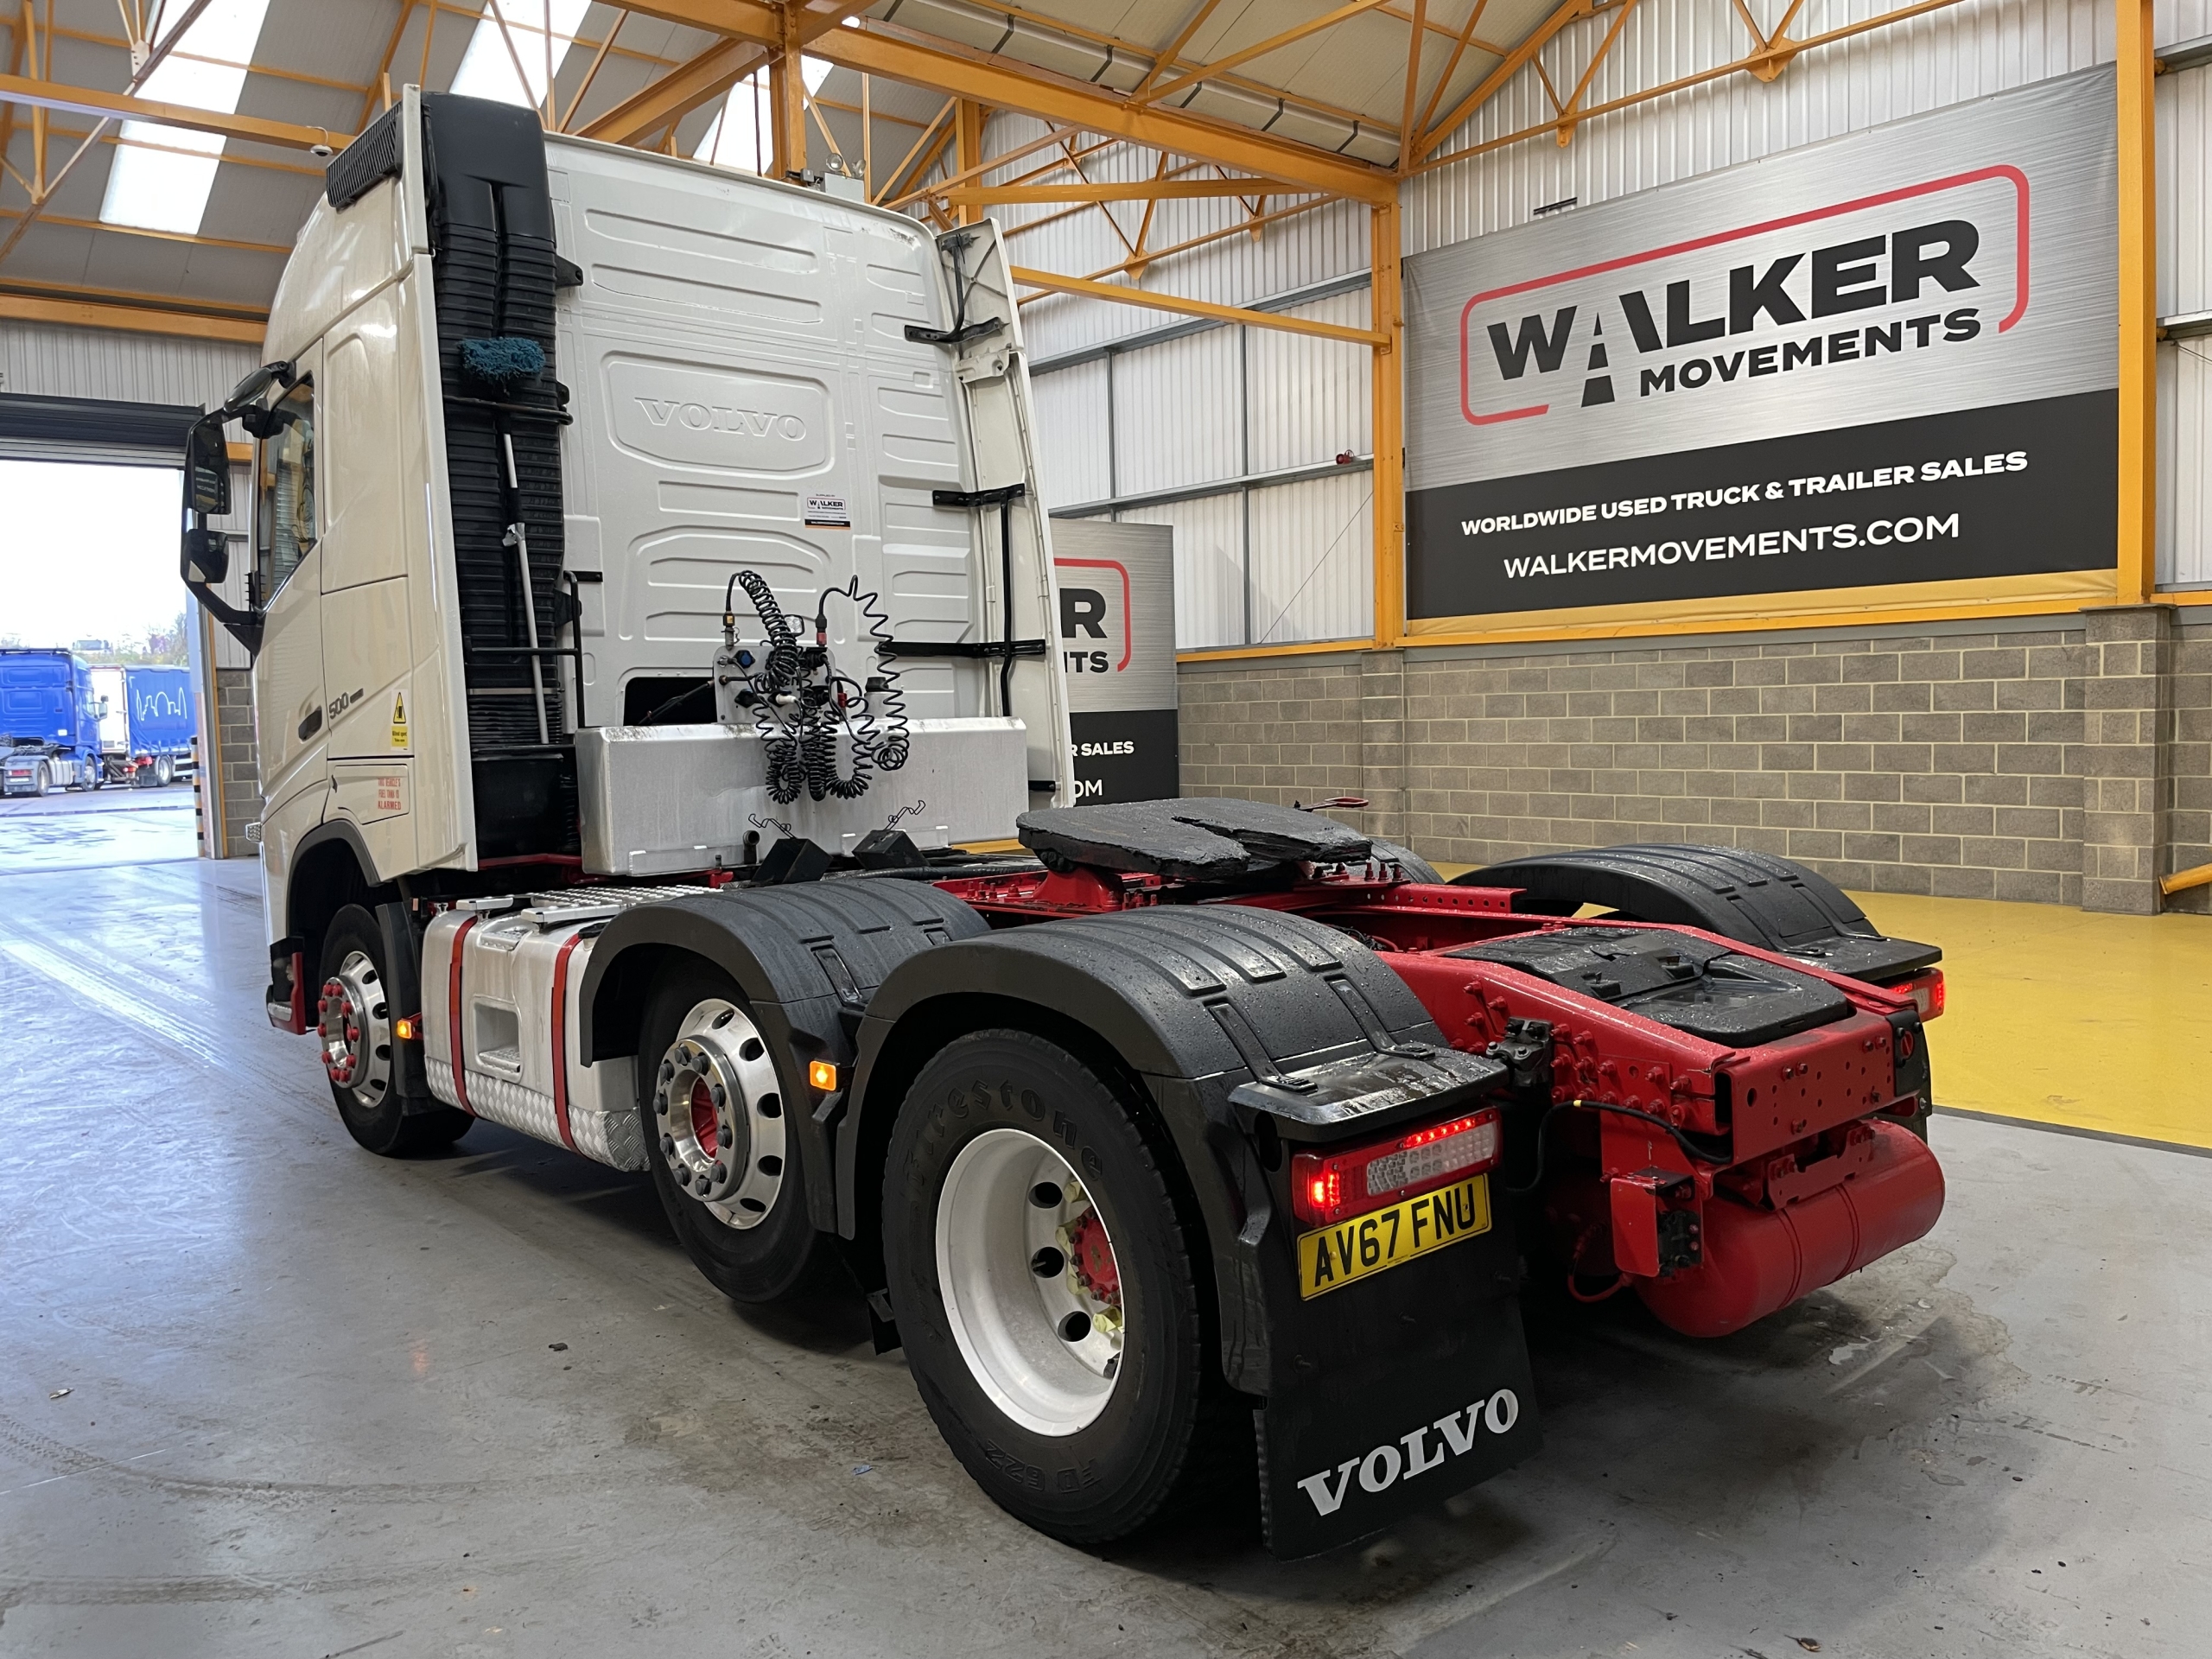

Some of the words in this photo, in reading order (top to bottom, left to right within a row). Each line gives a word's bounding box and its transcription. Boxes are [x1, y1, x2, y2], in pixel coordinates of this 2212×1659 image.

[1487, 220, 1981, 407] WALKER
[1641, 308, 1980, 397] MOVEMENTS
[634, 397, 806, 441] VOLVO
[809, 499, 843, 510] WALKER
[1462, 505, 1597, 536] WORLDWIDE
[1601, 497, 1668, 518] USED
[1671, 485, 1760, 510] TRUCK
[1764, 482, 1784, 500] &
[1788, 466, 1915, 497] TRAILER
[1920, 451, 2028, 481] SALES
[1503, 513, 1959, 579] WALKERMOVEMENTS.COM
[329, 691, 349, 720] 500
[1081, 741, 1135, 757] SALES
[378, 800, 402, 810] ALARMED
[1314, 1209, 1401, 1287] AV67
[1411, 1182, 1476, 1249] FNU
[1297, 1389, 1519, 1516] VOLVO
